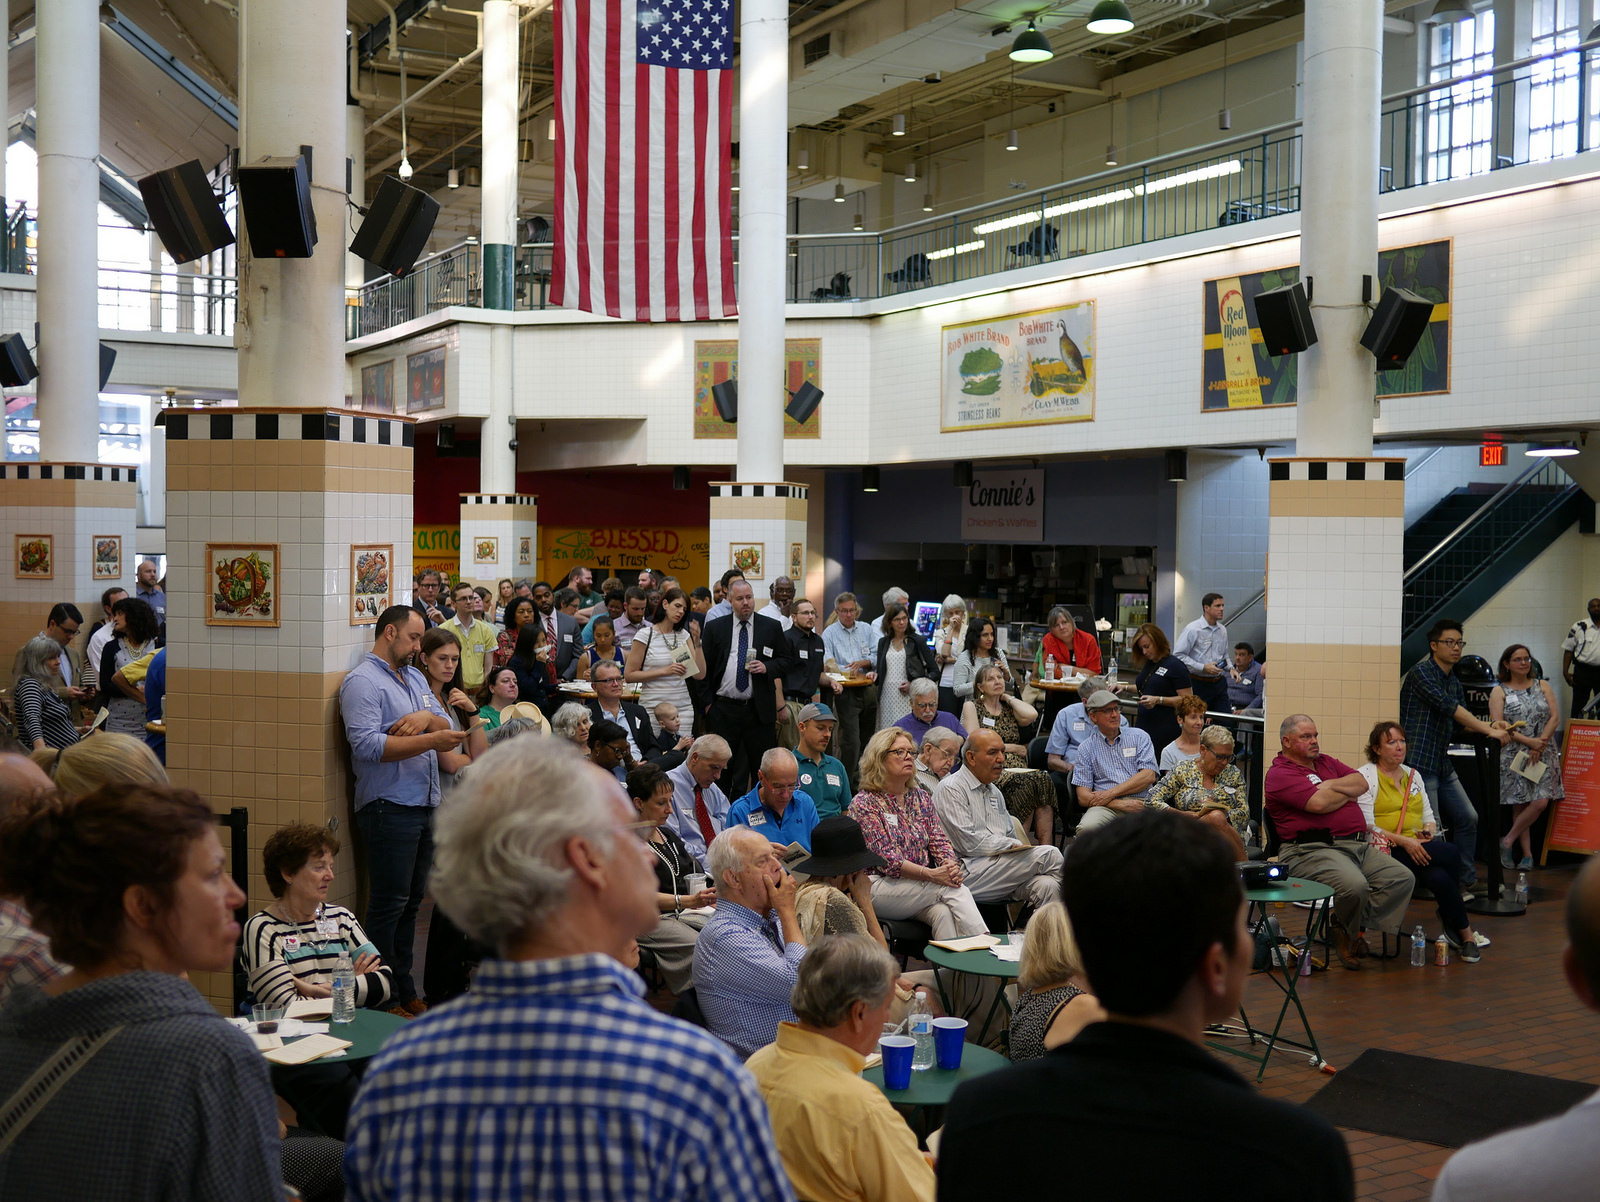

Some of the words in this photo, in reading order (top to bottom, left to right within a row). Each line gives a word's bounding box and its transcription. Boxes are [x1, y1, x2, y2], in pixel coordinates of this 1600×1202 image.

[1227, 306, 1244, 324] Red
[1032, 319, 1054, 334] WHITE
[1224, 324, 1247, 340] Moon
[962, 330, 985, 346] WHITE
[986, 328, 1010, 348] BRAND
[986, 408, 1000, 419] BEANS
[1483, 446, 1502, 464] EXIT
[969, 478, 1036, 506] Connie's
[590, 528, 680, 554] BLESSED
